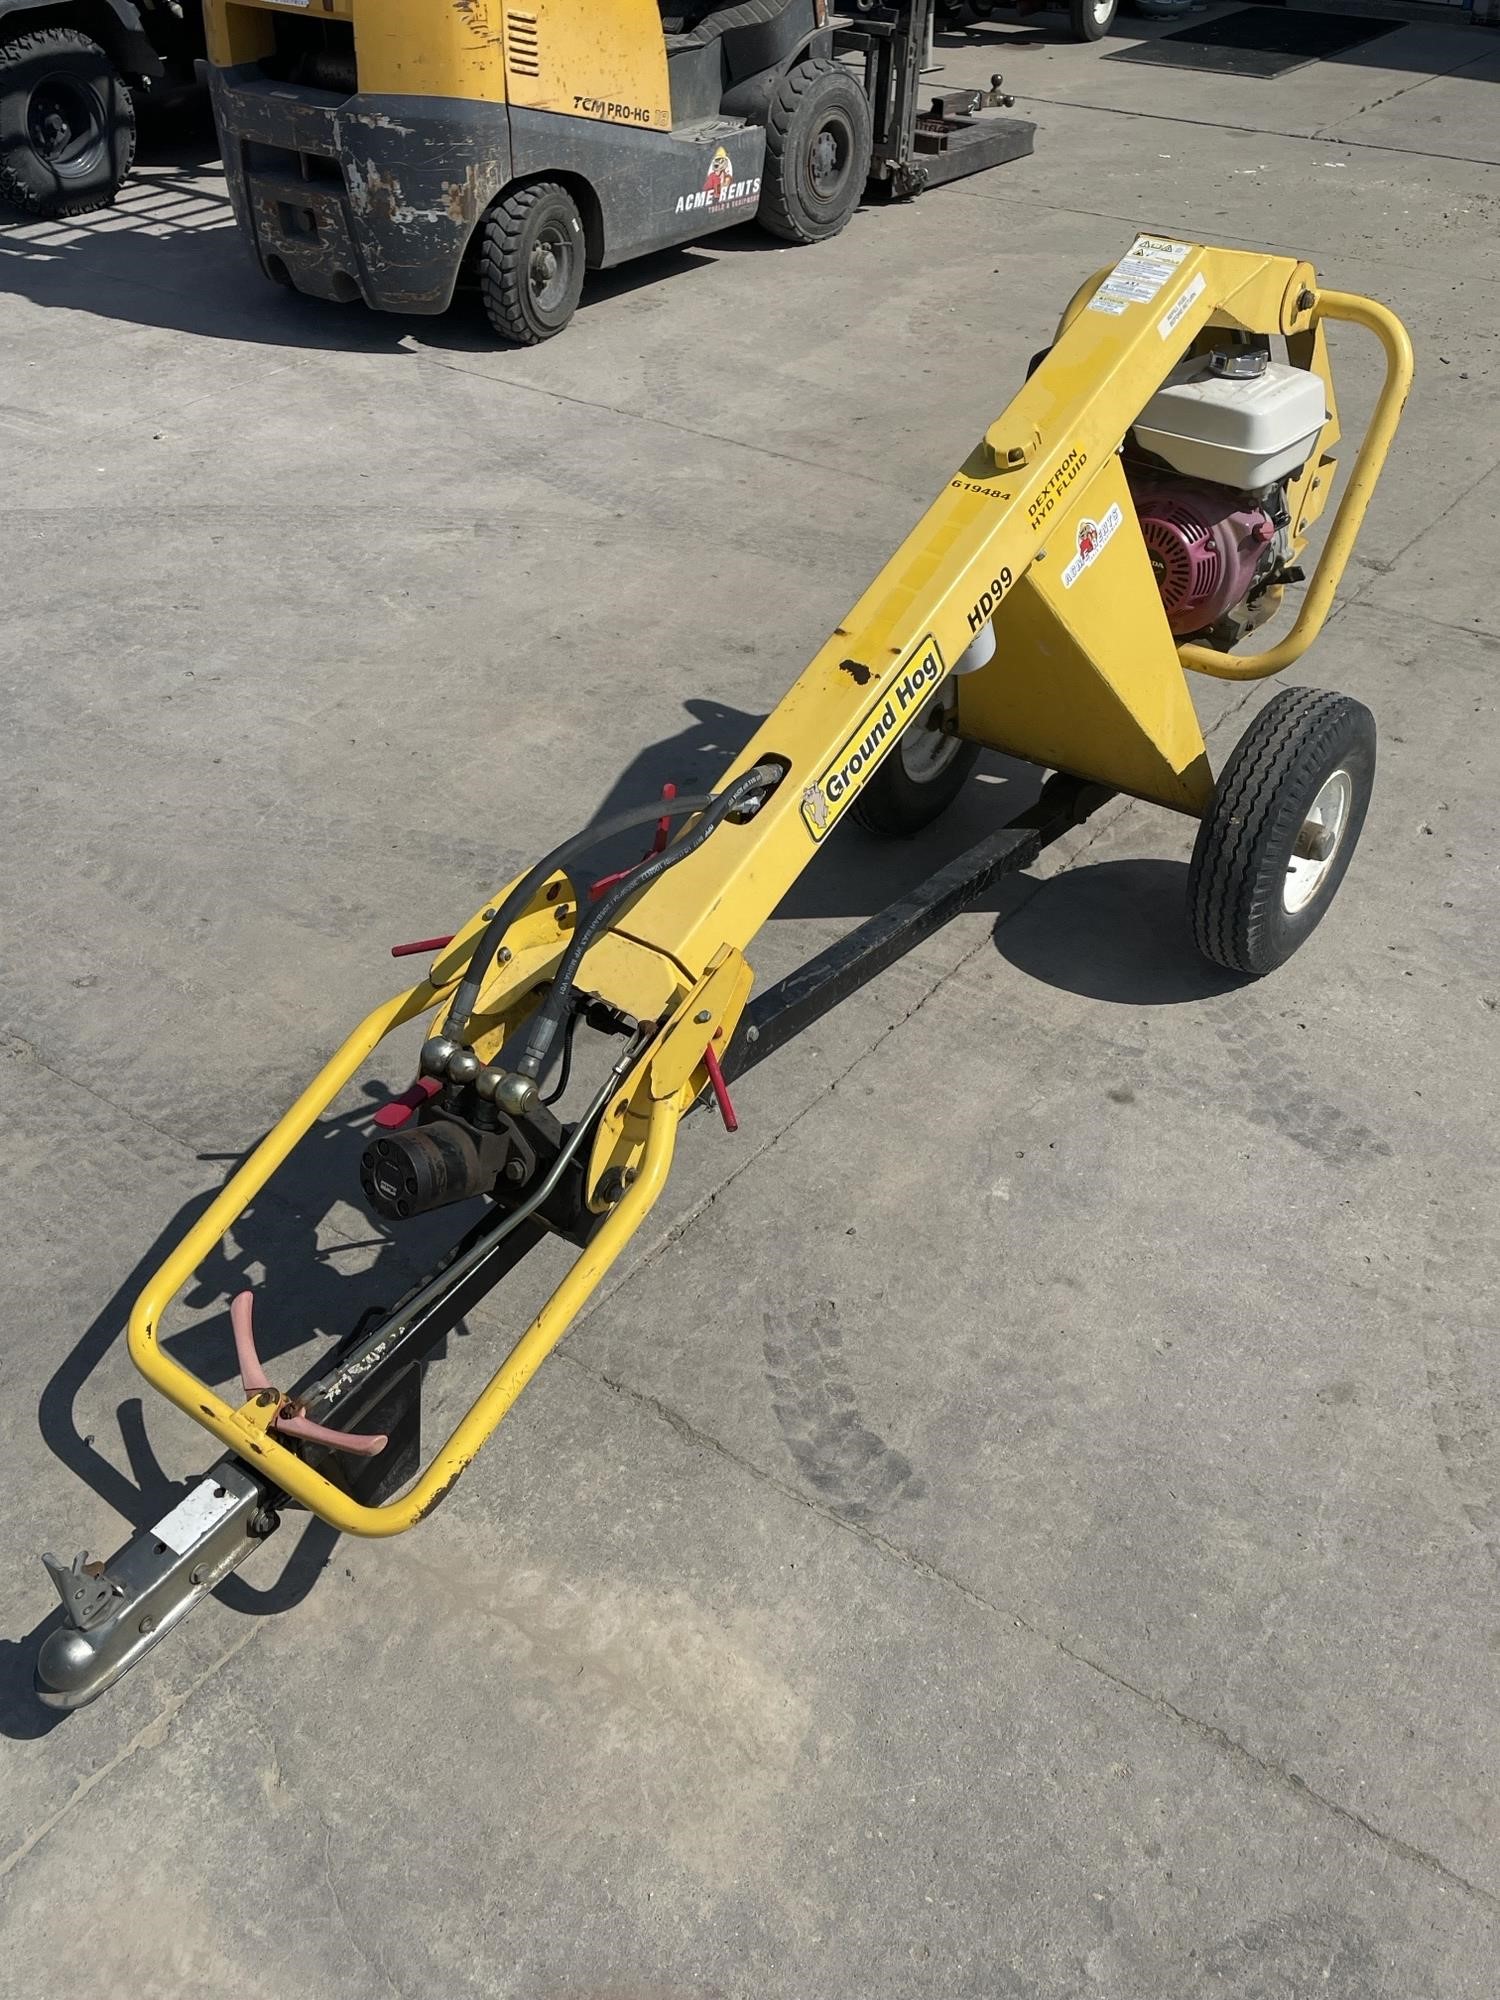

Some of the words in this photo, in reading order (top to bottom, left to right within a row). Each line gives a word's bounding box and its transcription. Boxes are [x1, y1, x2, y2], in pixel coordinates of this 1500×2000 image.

[607, 103, 650, 122] PRO-HG
[675, 189, 715, 214] ACME
[718, 178, 761, 202] RENTS
[951, 479, 1011, 501] 619484
[1028, 448, 1077, 517] DEXTRON
[1031, 498, 1054, 530] HYD
[1056, 453, 1087, 496] FLUID
[967, 566, 1013, 633] HD99
[825, 703, 897, 802] Ground
[895, 652, 938, 710] Hog
